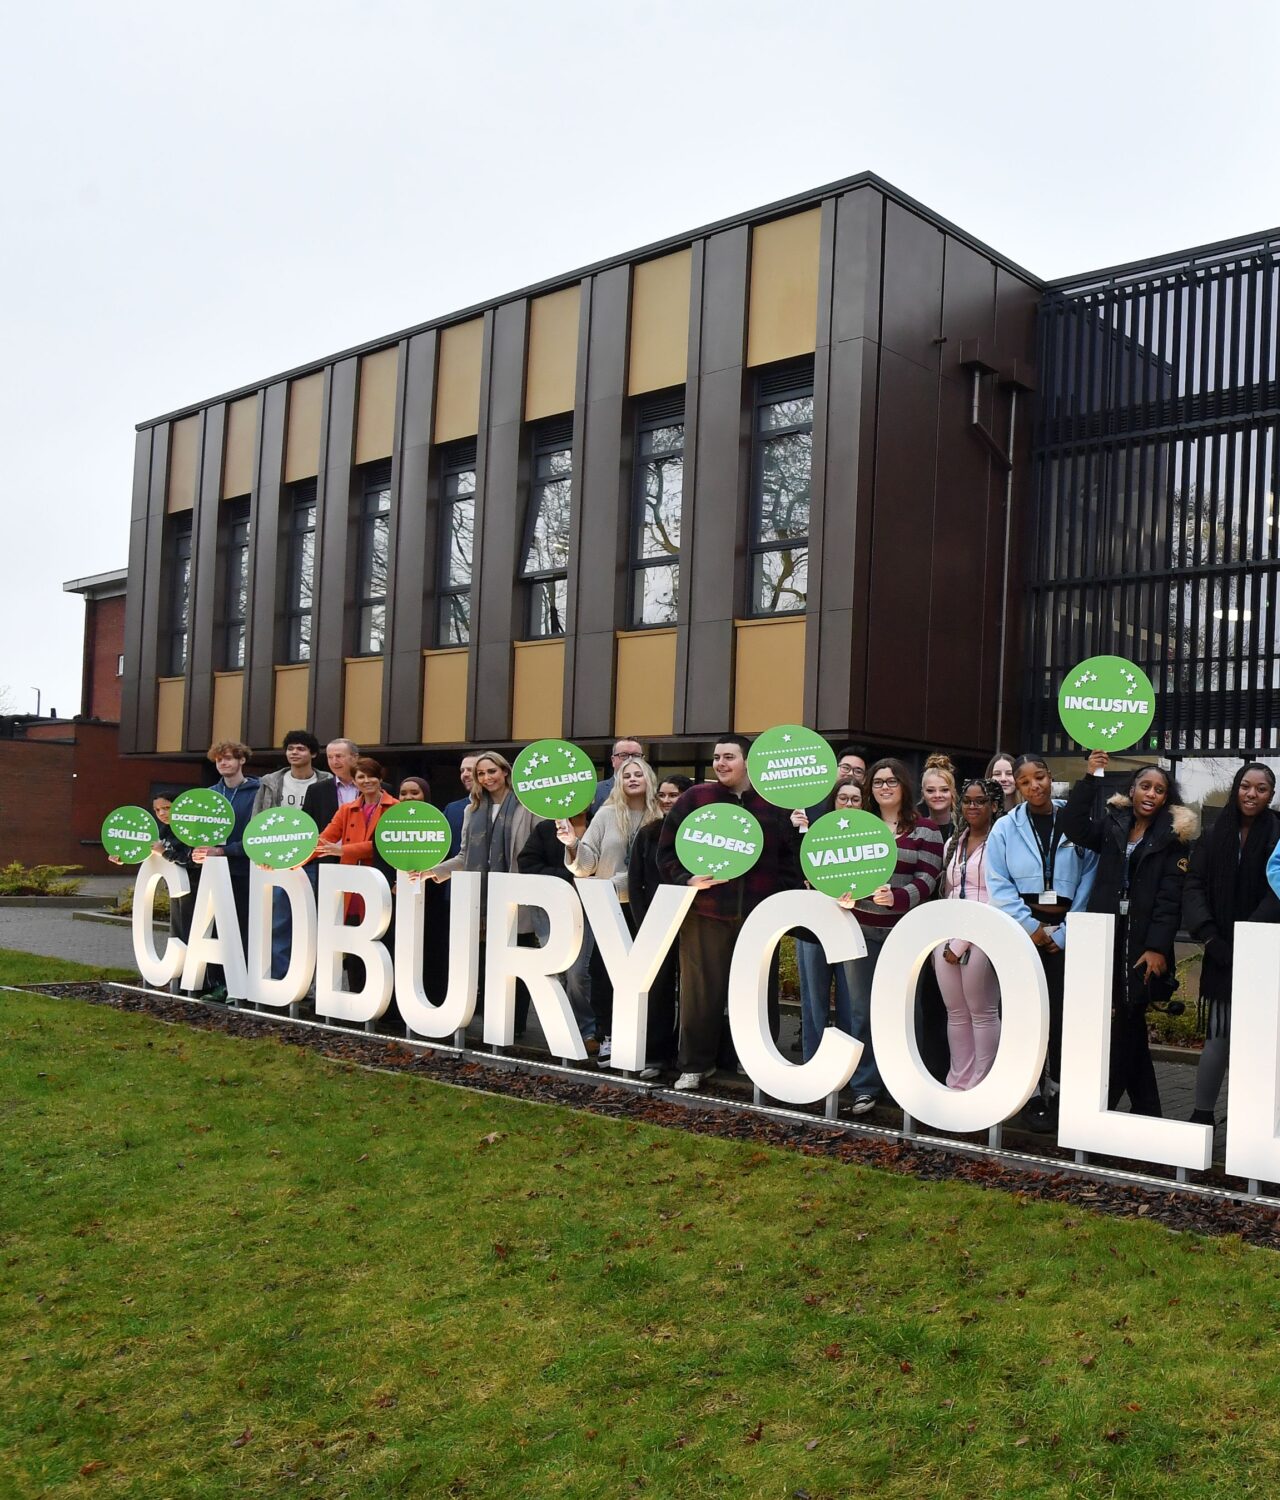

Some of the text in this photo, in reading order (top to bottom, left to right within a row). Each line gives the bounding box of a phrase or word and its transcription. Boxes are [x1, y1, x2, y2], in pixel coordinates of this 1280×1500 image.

[1063, 694, 1149, 714] INCLUSIVE
[766, 754, 817, 770] ALWAYS
[517, 770, 593, 792] EXCELLENCE
[759, 764, 828, 782] AMBITIOUS
[171, 812, 232, 826] EXCEPTIONAL
[107, 827, 152, 842] SKILLED
[246, 830, 314, 846] COMMUNITY
[380, 829, 446, 842] CULTURE
[681, 826, 757, 855] LEADERS
[806, 842, 890, 868] VALUED
[132, 855, 700, 1072] CADBURY
